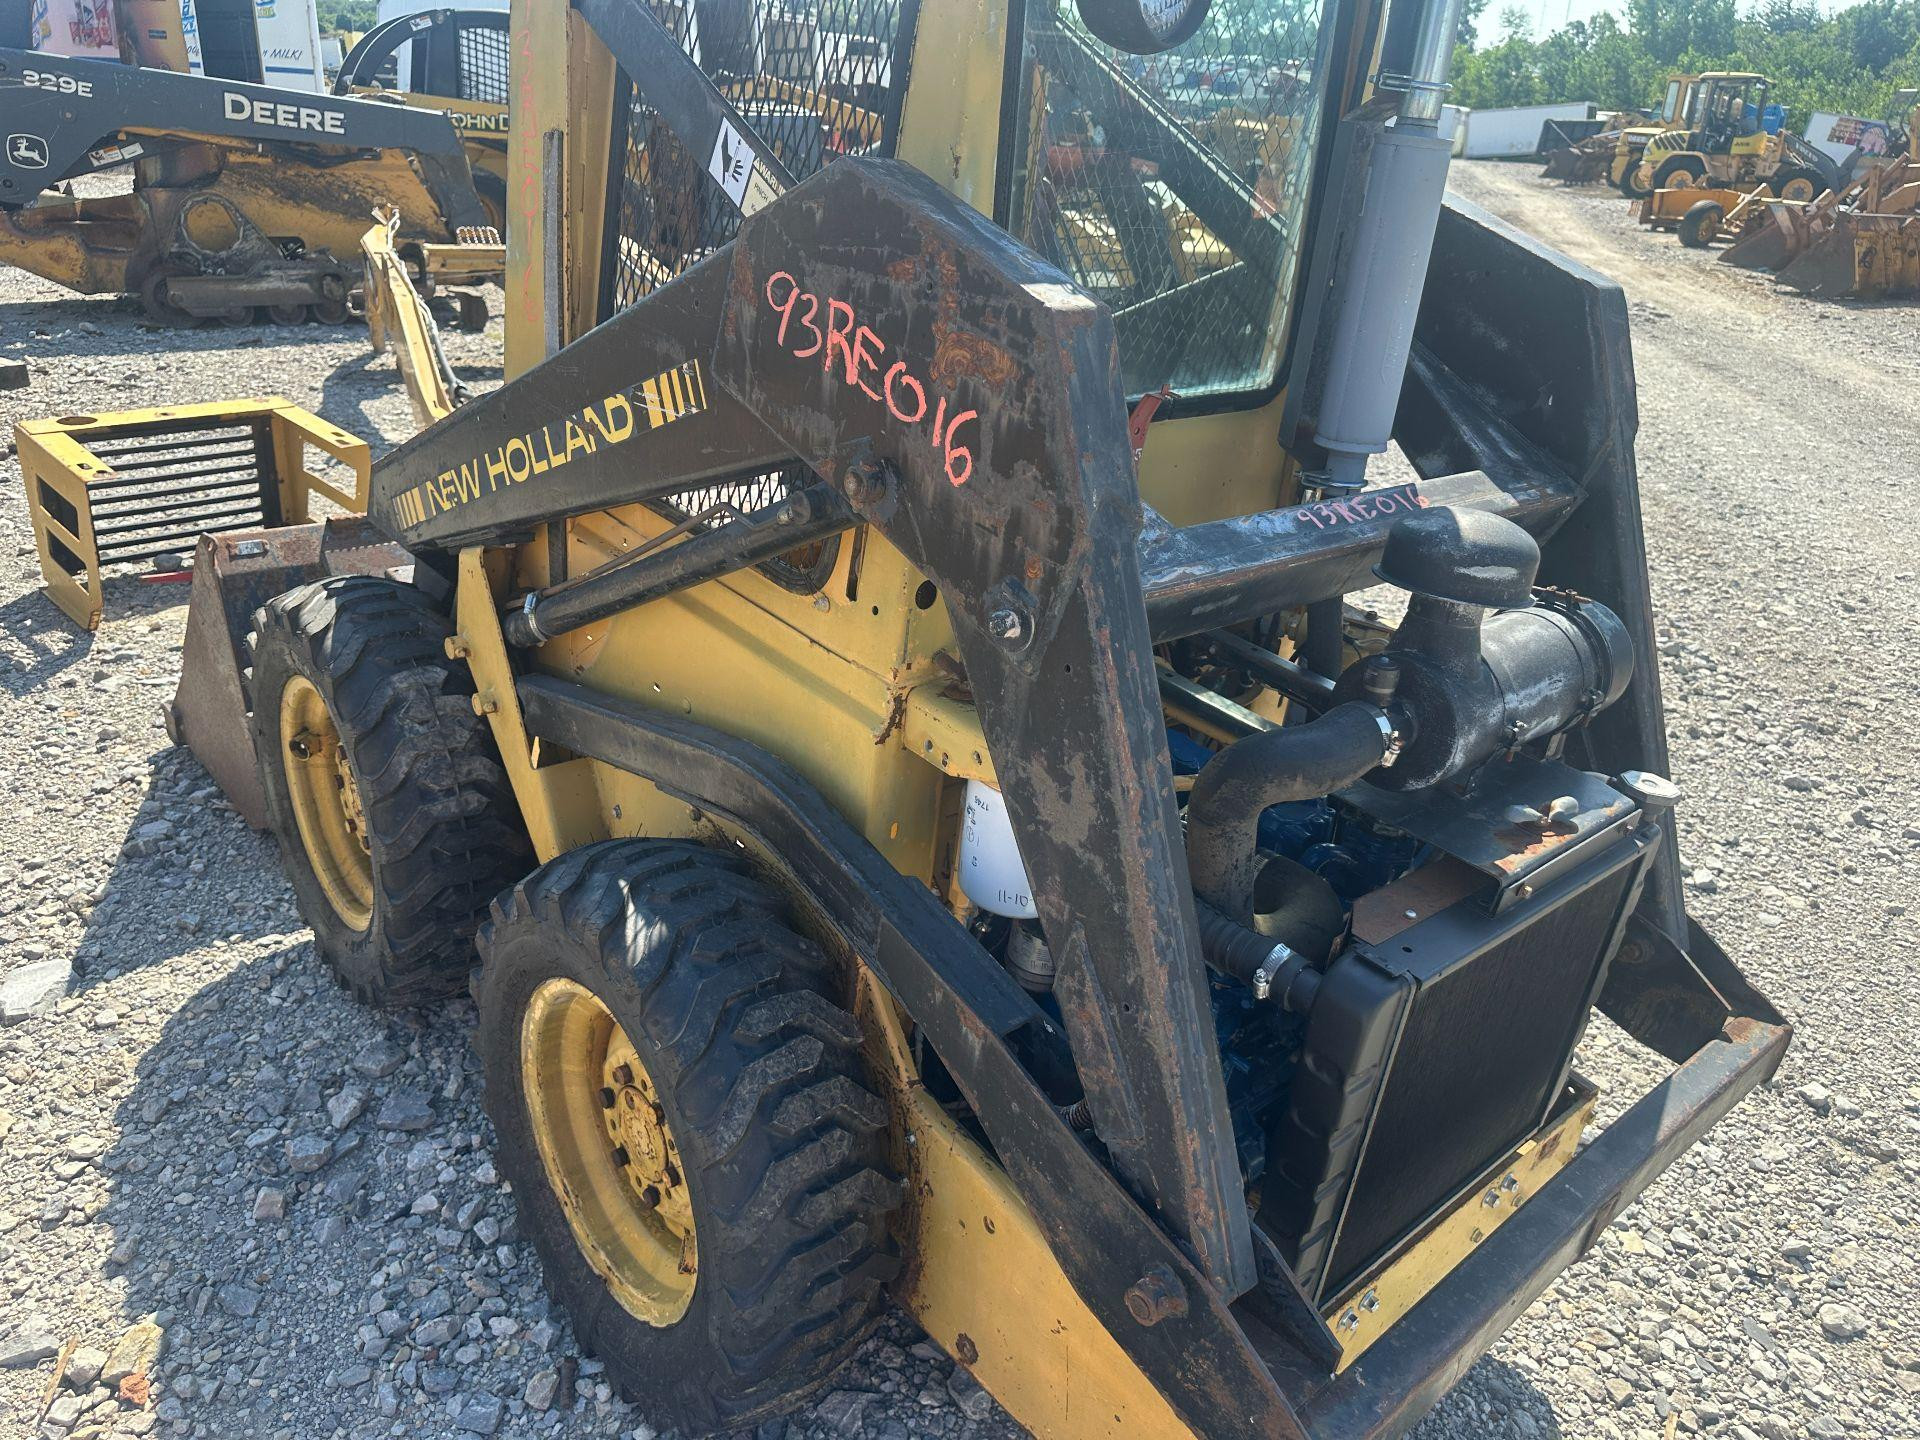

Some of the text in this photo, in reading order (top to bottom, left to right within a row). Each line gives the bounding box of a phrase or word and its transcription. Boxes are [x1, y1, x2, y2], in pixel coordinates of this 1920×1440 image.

[22, 69, 93, 98] 329E
[224, 91, 345, 135] DEERE
[766, 270, 978, 488] 93RE016
[425, 393, 635, 517] NEW HOLLAND
[1296, 486, 1430, 530] 93RE016
